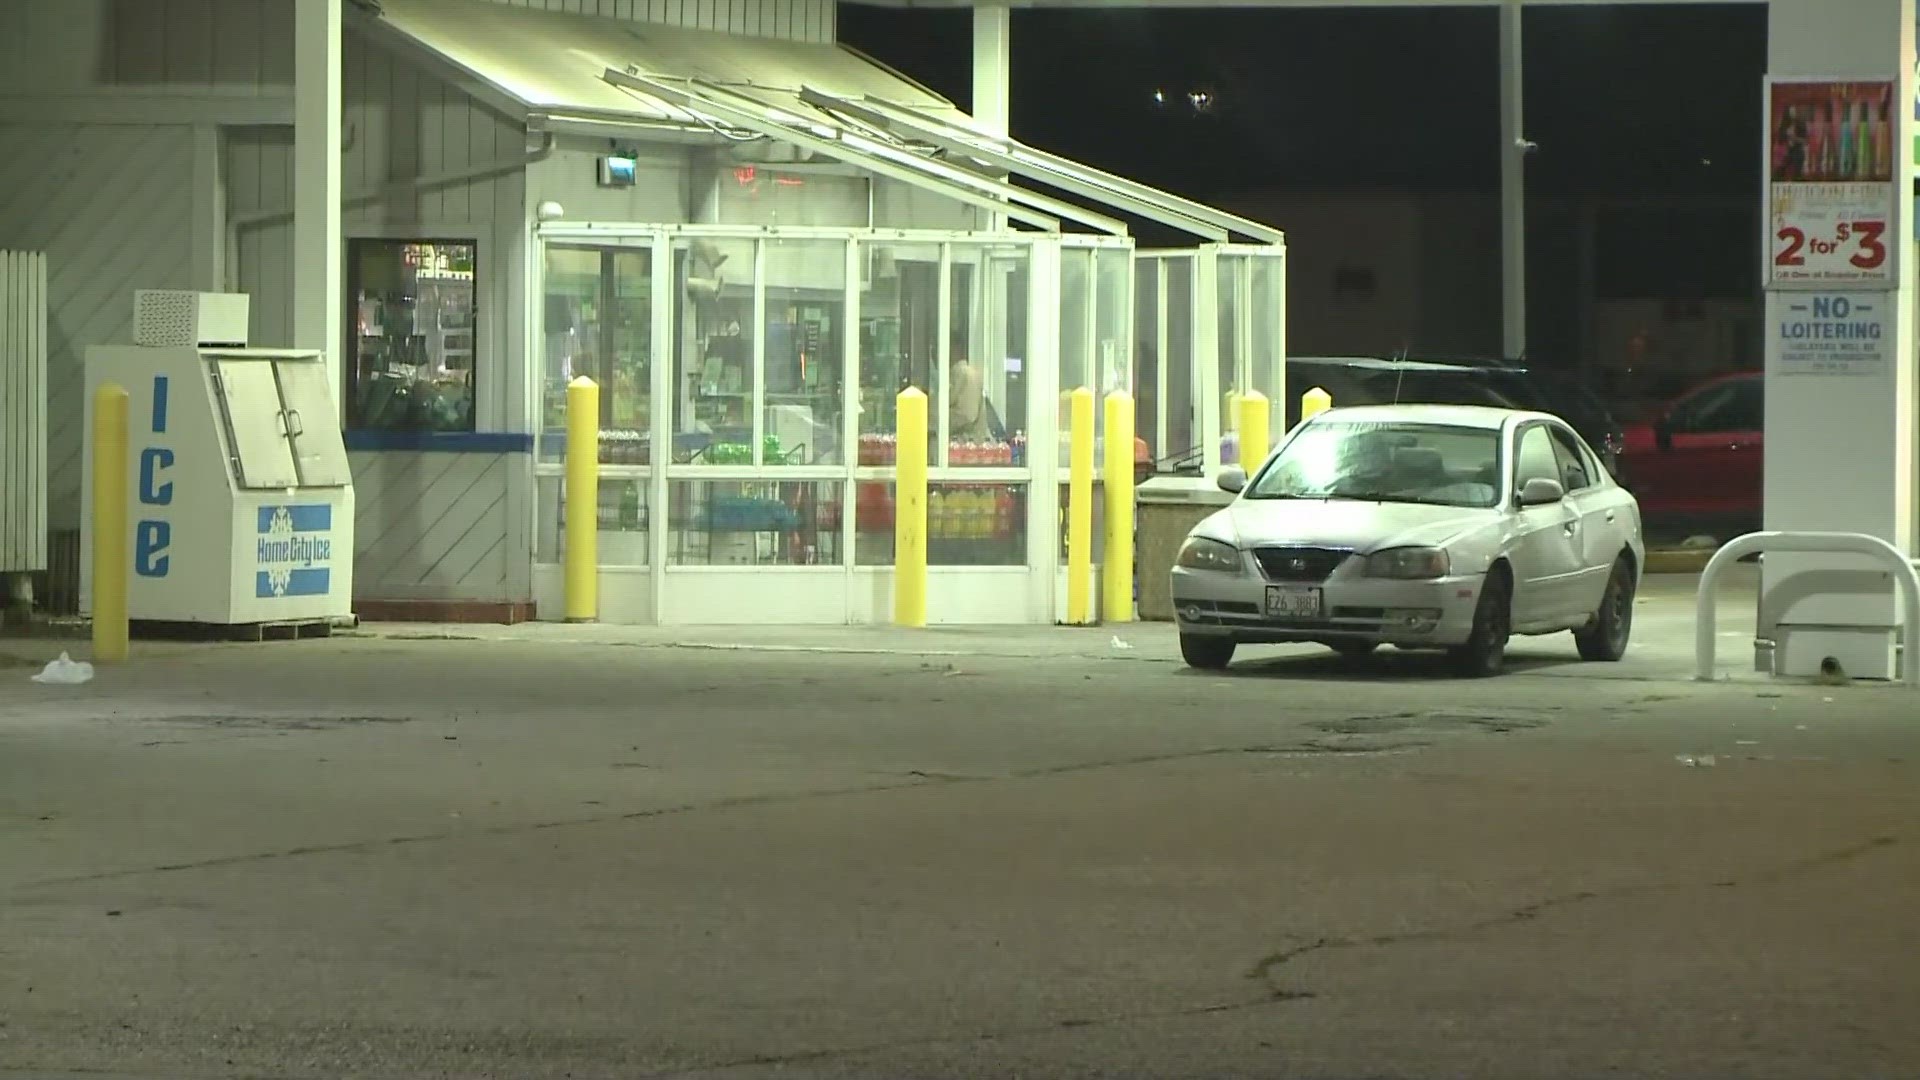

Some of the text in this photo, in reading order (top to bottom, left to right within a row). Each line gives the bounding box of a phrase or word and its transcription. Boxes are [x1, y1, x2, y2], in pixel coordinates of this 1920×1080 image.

[1775, 221, 1886, 269] 2 for $3
[1813, 297, 1850, 318] NO
[1781, 322, 1881, 339] LOITERING
[135, 376, 175, 578] Ice
[258, 535, 331, 567] Home City Ice
